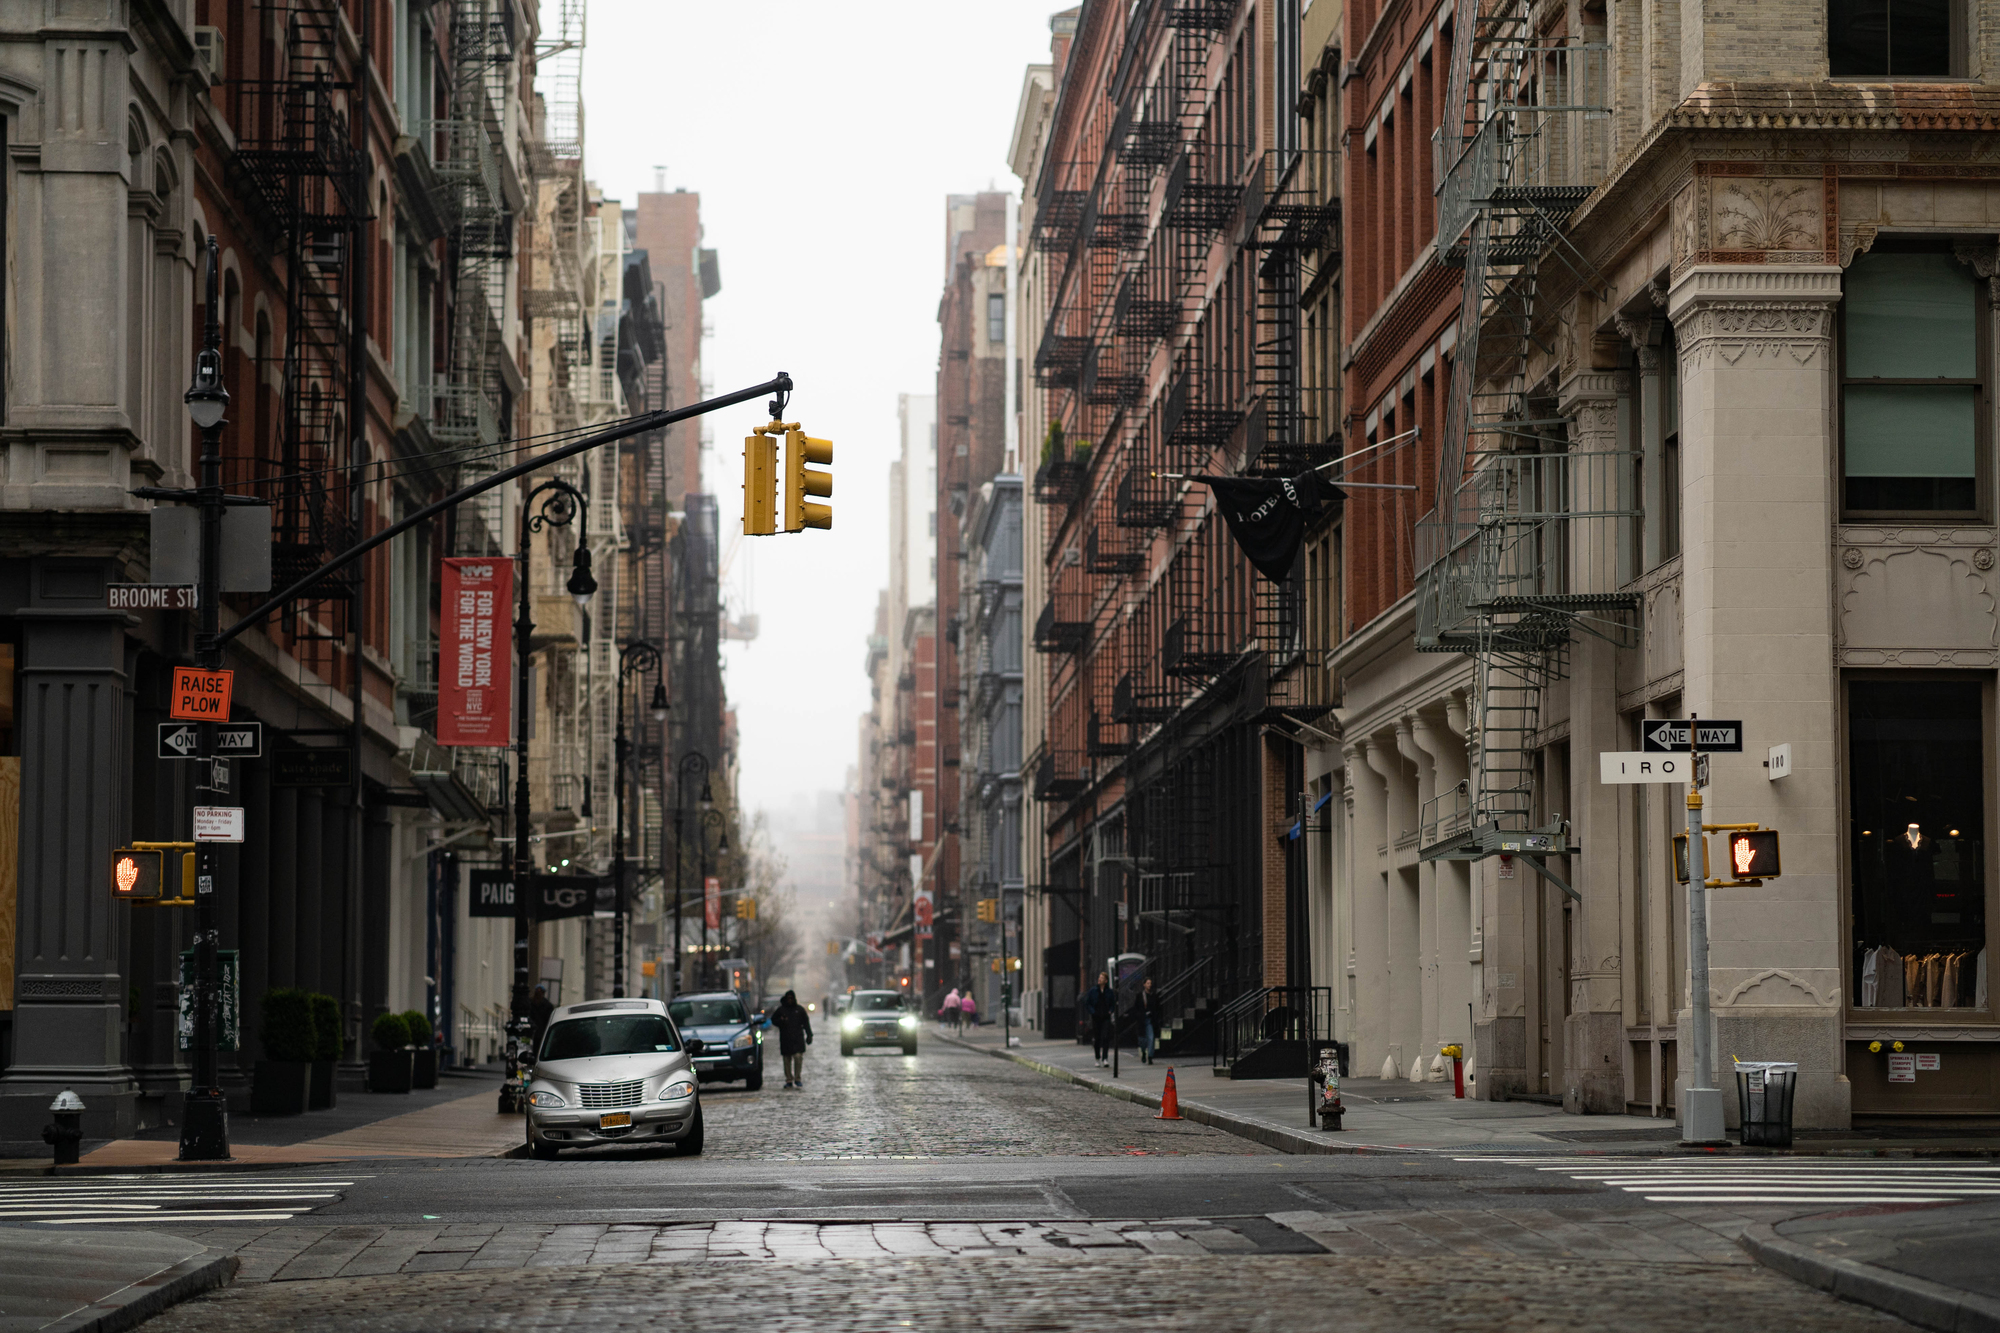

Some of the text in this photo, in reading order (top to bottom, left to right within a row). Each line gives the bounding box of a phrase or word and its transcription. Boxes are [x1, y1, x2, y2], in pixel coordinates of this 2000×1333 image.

[460, 565, 493, 577] NYC
[109, 588, 193, 608] BROOME ST
[460, 590, 475, 614] FOR
[459, 616, 475, 641] THE
[475, 591, 493, 687] FOR NEW YORK
[458, 643, 474, 687] WORLD
[181, 675, 225, 694] RAISE
[181, 696, 221, 713] PLOW
[466, 702, 482, 711] NYC
[217, 733, 247, 746] WAY
[1658, 730, 1729, 743] ONE WAY
[1772, 754, 1784, 769] IRO
[207, 810, 232, 818] PARKING
[480, 882, 515, 904] PAIG
[543, 888, 587, 908] UGG
